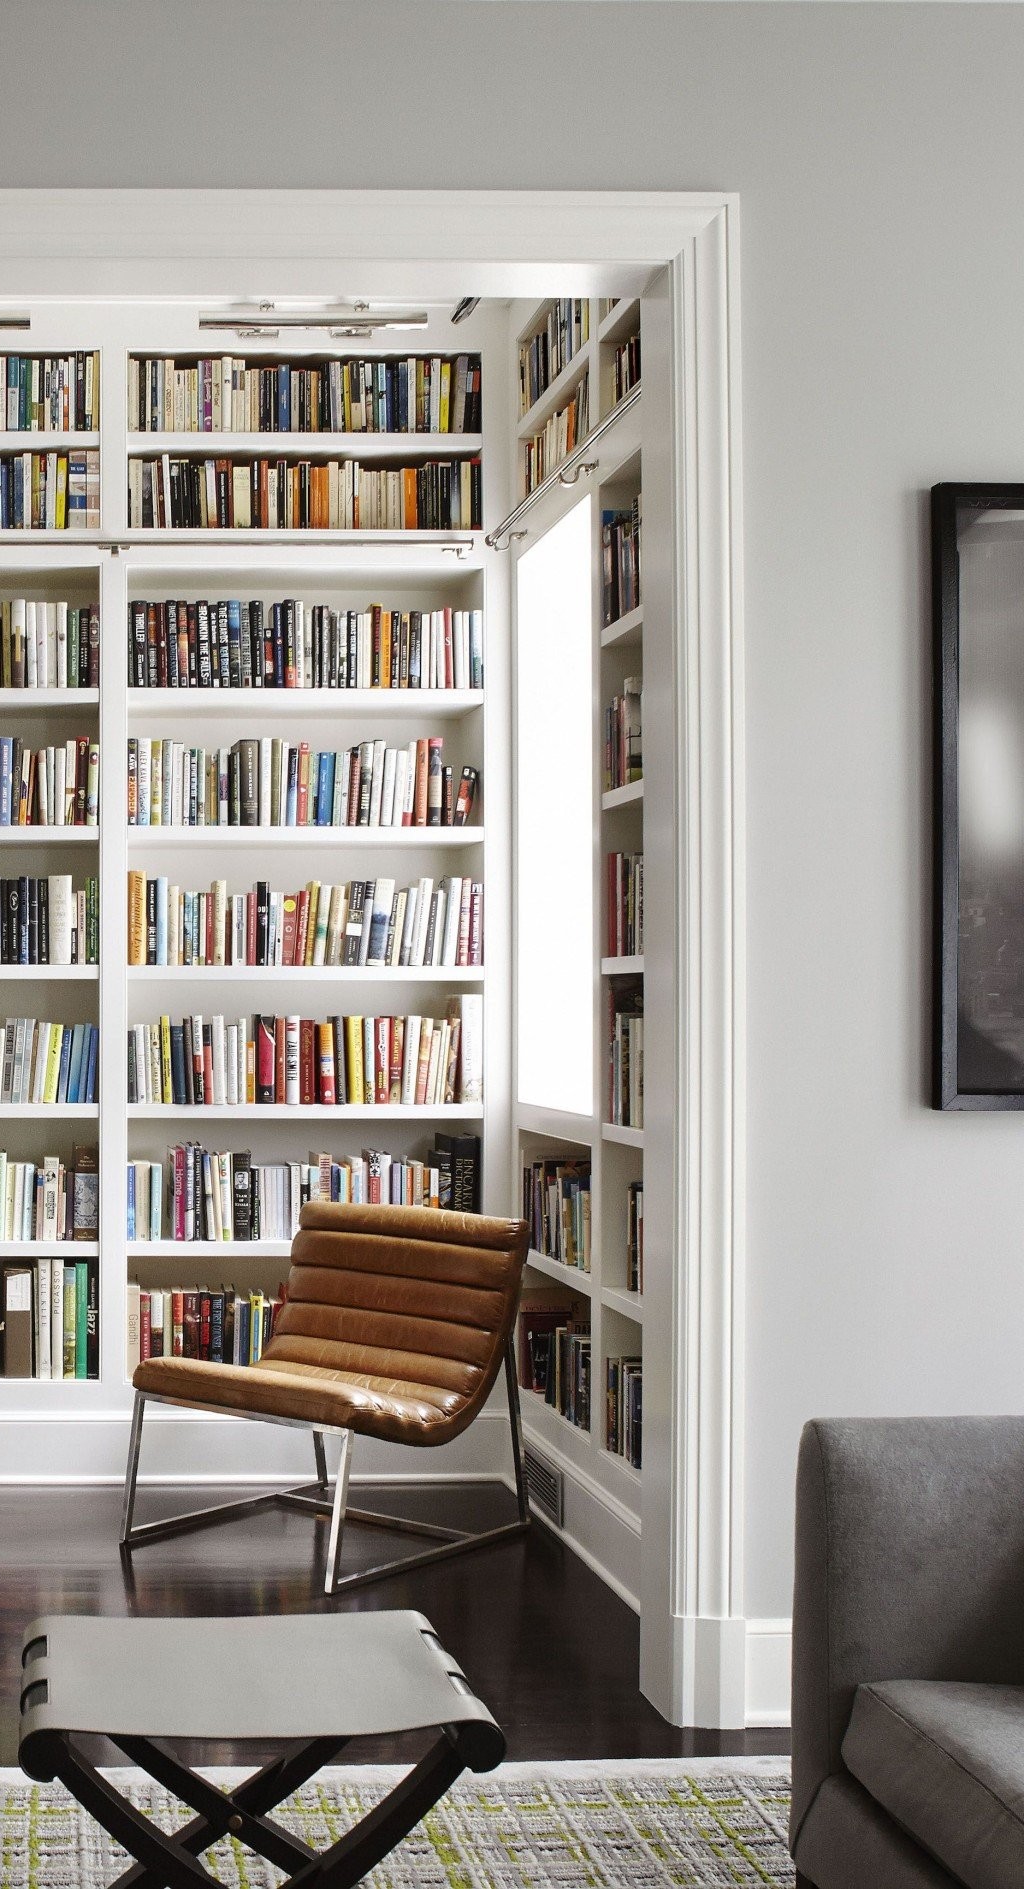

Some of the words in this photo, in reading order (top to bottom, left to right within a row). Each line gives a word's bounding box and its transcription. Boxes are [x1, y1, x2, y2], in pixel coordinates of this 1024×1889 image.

[219, 607, 227, 618] THE
[136, 613, 145, 642] THRILLER
[199, 611, 208, 641] RANKIN
[219, 619, 228, 643] GUARDS
[200, 643, 209, 655] THE
[201, 657, 210, 678] FALLS
[129, 753, 137, 771] KAVA
[135, 875, 144, 935] Rembrandt's
[134, 938, 142, 959] Eyes
[286, 1022, 297, 1033] NW
[287, 1040, 298, 1058] ZADIE
[287, 1060, 298, 1081] SMITH
[175, 1169, 184, 1196] Home
[212, 1298, 222, 1310] THE
[87, 1304, 98, 1335] Jazz
[212, 1310, 222, 1324] FIRST
[128, 1314, 139, 1345] Gandhi
